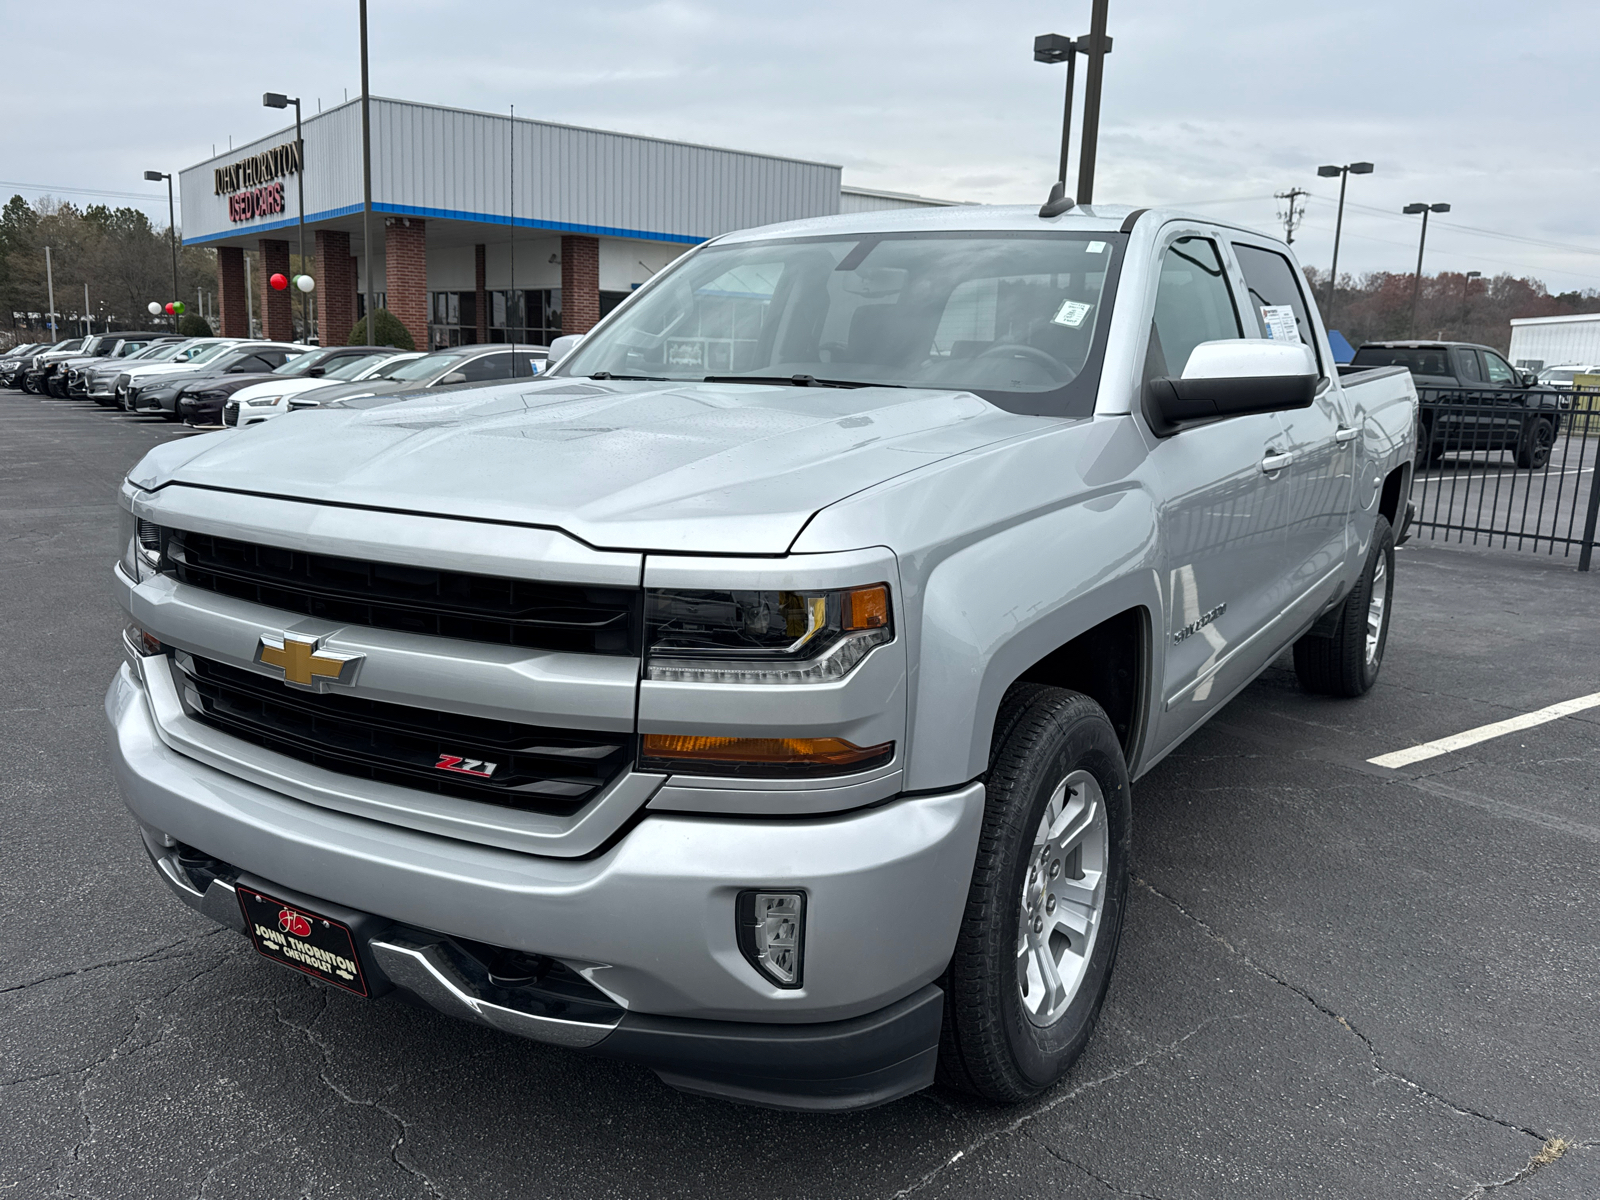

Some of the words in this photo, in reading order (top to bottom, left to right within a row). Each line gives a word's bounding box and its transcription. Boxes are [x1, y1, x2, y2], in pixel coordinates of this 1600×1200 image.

[214, 164, 240, 195] JOHN
[228, 191, 254, 222] USED
[254, 182, 285, 216] CARS
[435, 753, 498, 778] Z71
[254, 923, 287, 946] JOHN
[287, 936, 358, 975] THORNTON
[282, 946, 332, 974] CHEVROLET
